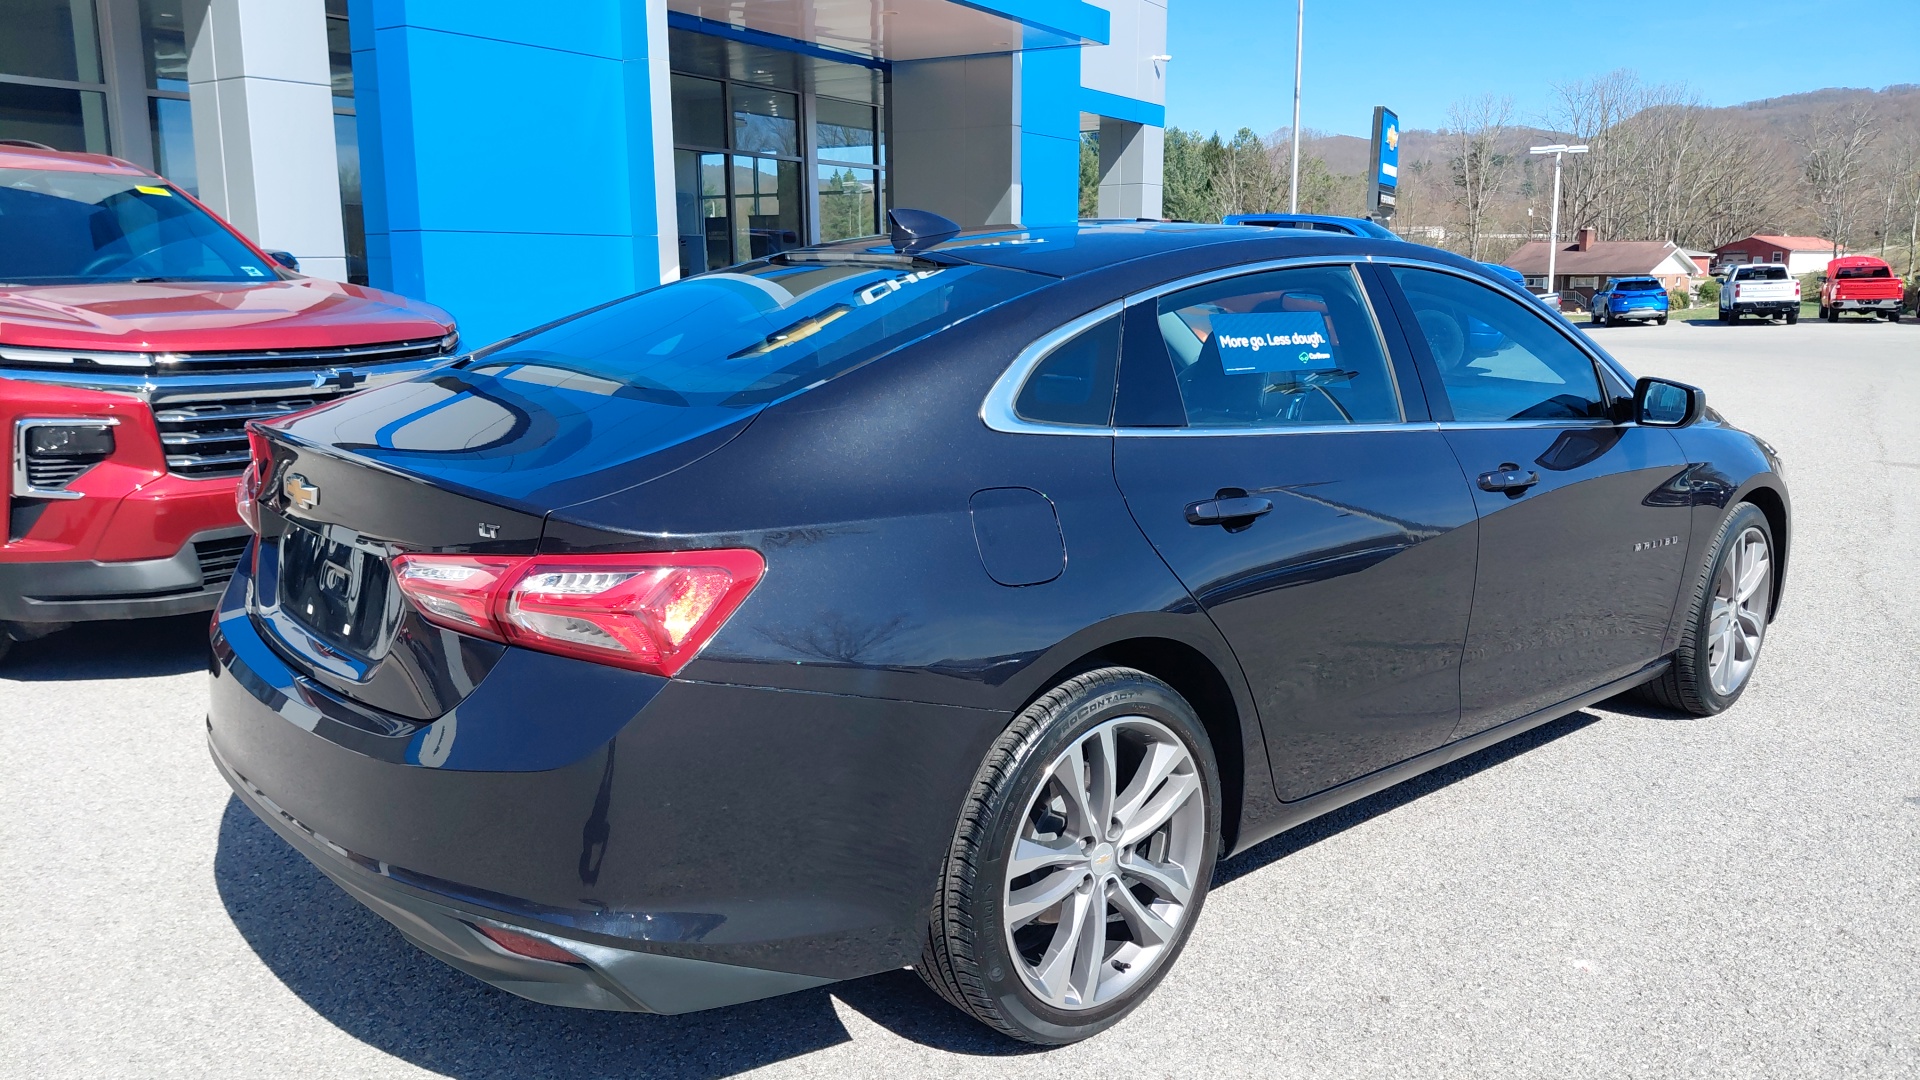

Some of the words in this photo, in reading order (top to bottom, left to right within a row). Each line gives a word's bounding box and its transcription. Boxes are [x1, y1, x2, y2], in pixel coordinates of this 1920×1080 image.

[1219, 334, 1249, 349] More
[1250, 337, 1267, 351] go.
[1266, 333, 1291, 346] Less
[1291, 332, 1326, 349] dough.
[479, 522, 501, 539] LT
[1633, 535, 1679, 552] MALIBU
